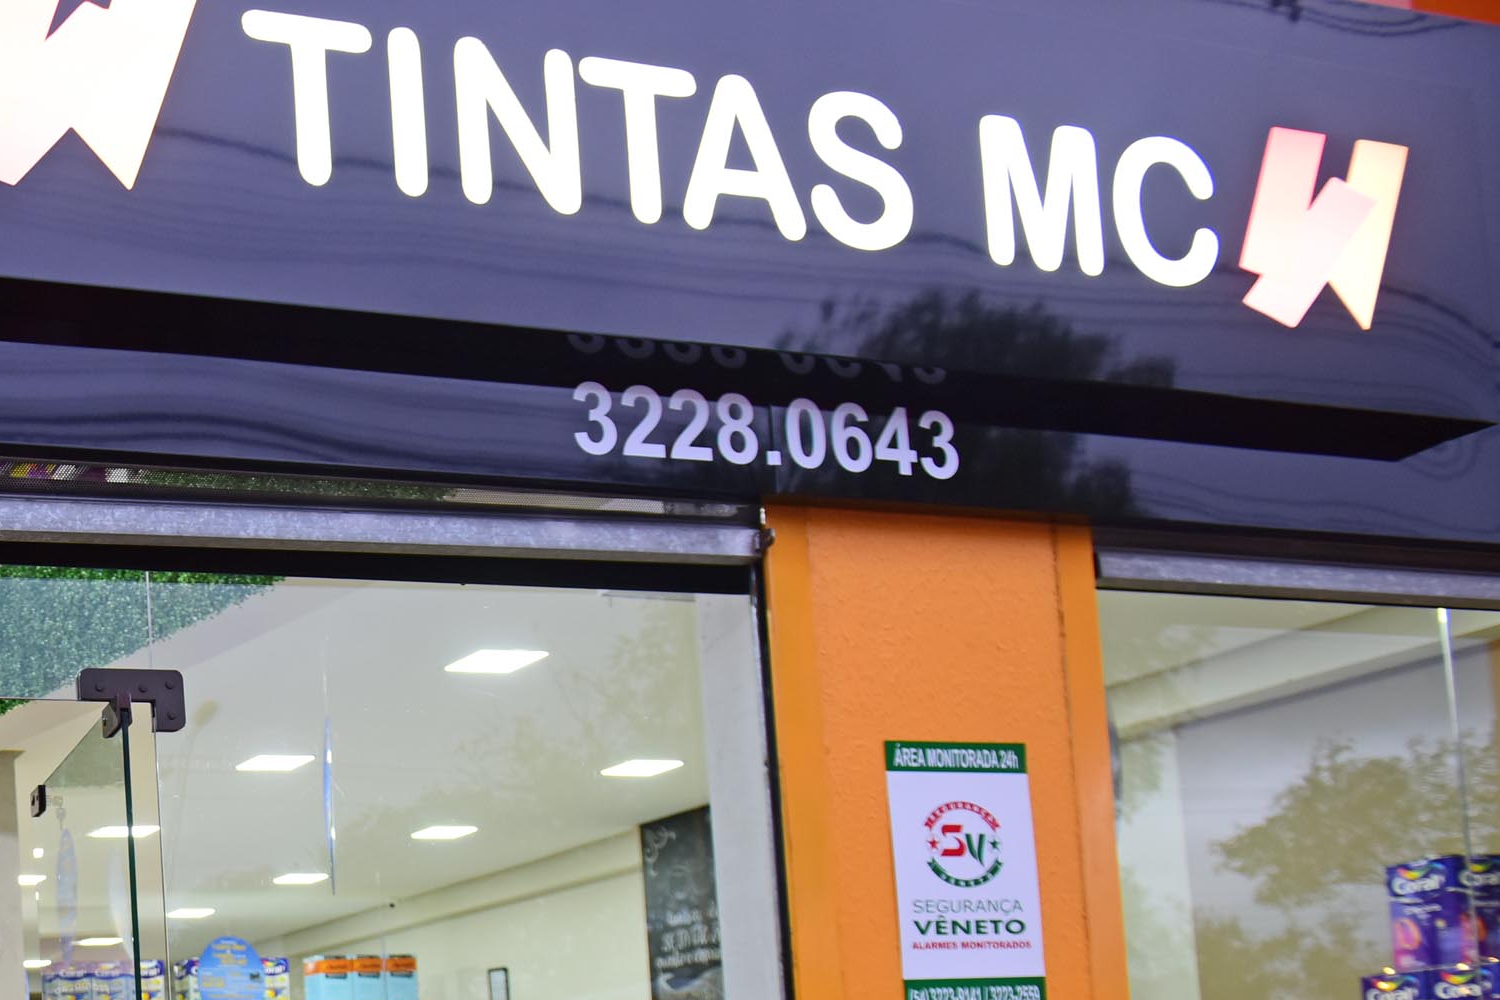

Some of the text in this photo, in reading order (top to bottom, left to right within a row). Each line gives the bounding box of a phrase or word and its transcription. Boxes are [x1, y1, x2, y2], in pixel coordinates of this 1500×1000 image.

[241, 9, 1219, 287] TINTAS MC
[573, 381, 959, 481] 3228.0643
[913, 899, 1024, 916] SEGURANÇA
[914, 914, 1026, 936] VÊNETO
[913, 941, 1032, 950] ALARMES MONITORADOS
